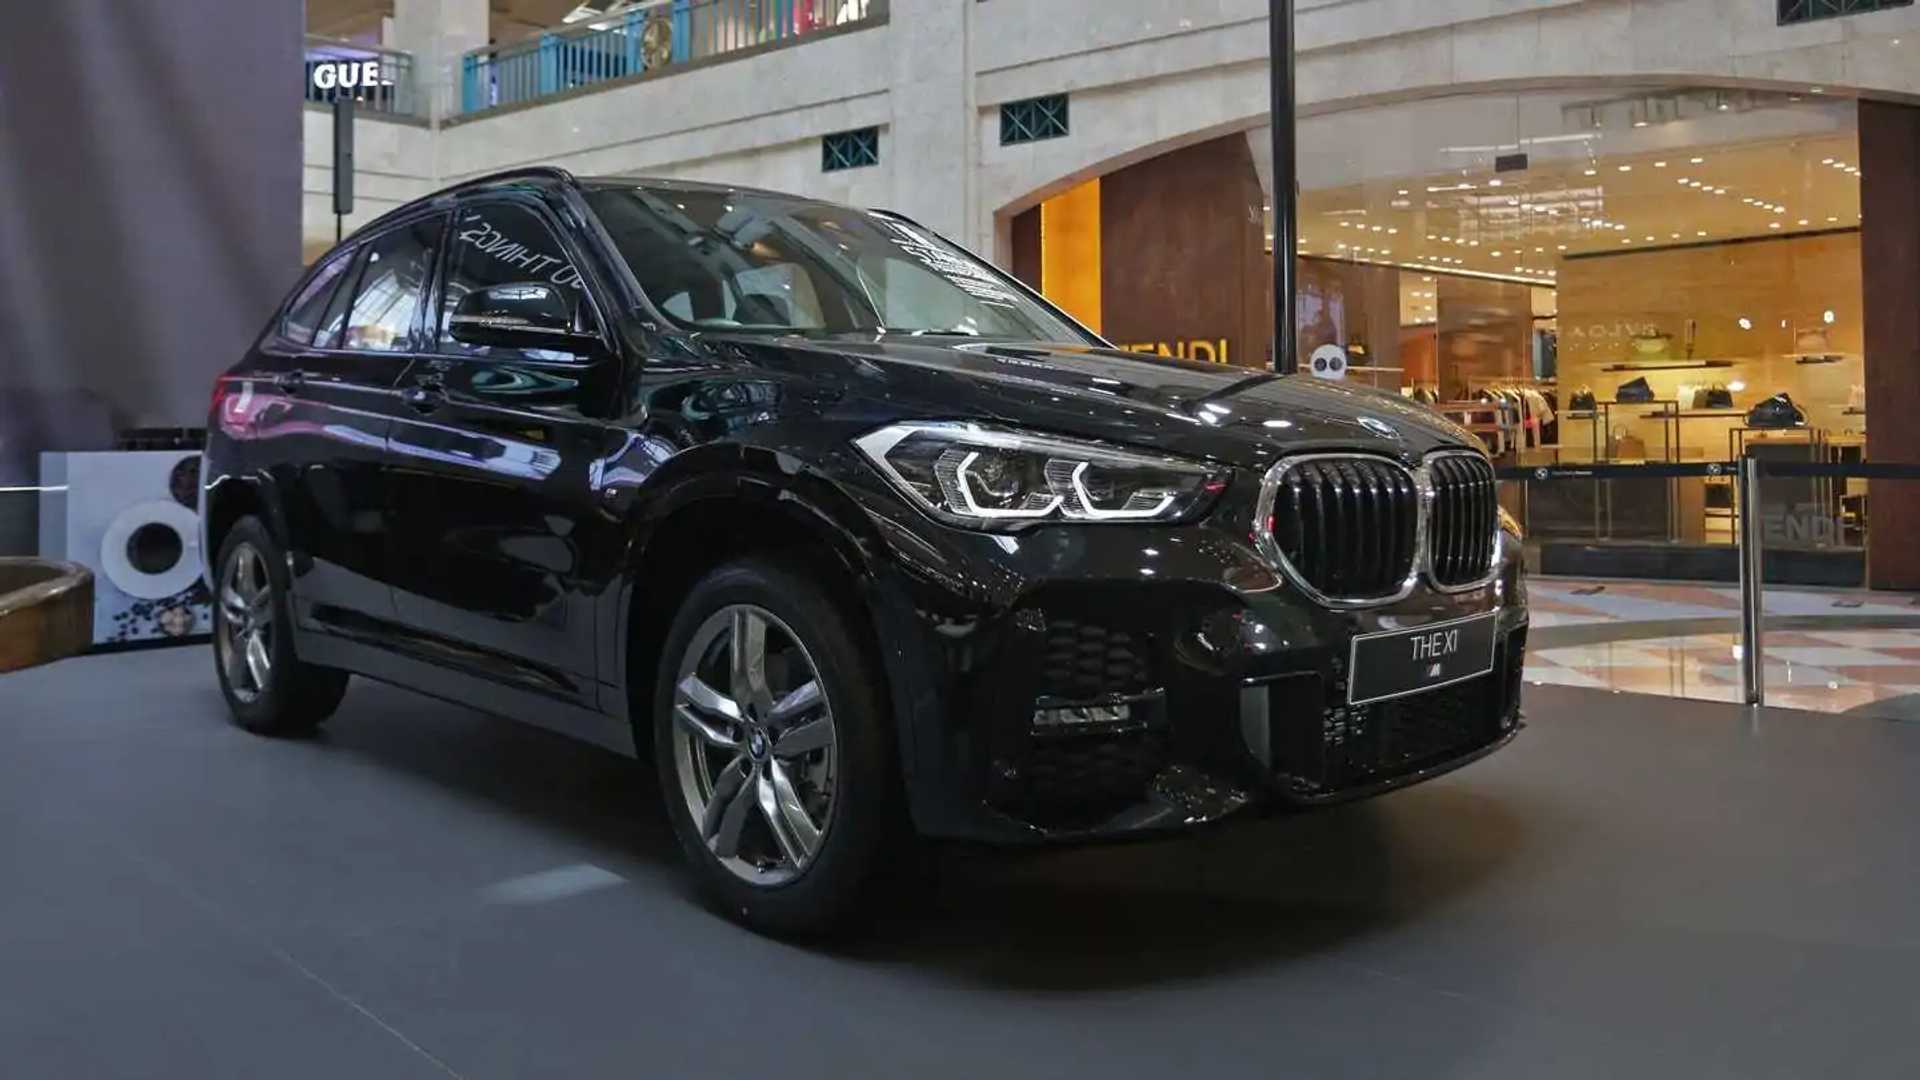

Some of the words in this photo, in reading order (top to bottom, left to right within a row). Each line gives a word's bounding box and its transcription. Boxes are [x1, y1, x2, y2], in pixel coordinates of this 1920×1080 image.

[313, 62, 394, 89] GUE
[1119, 338, 1227, 363] NDI
[1762, 512, 1846, 546] ENDI
[1410, 632, 1441, 660] THE
